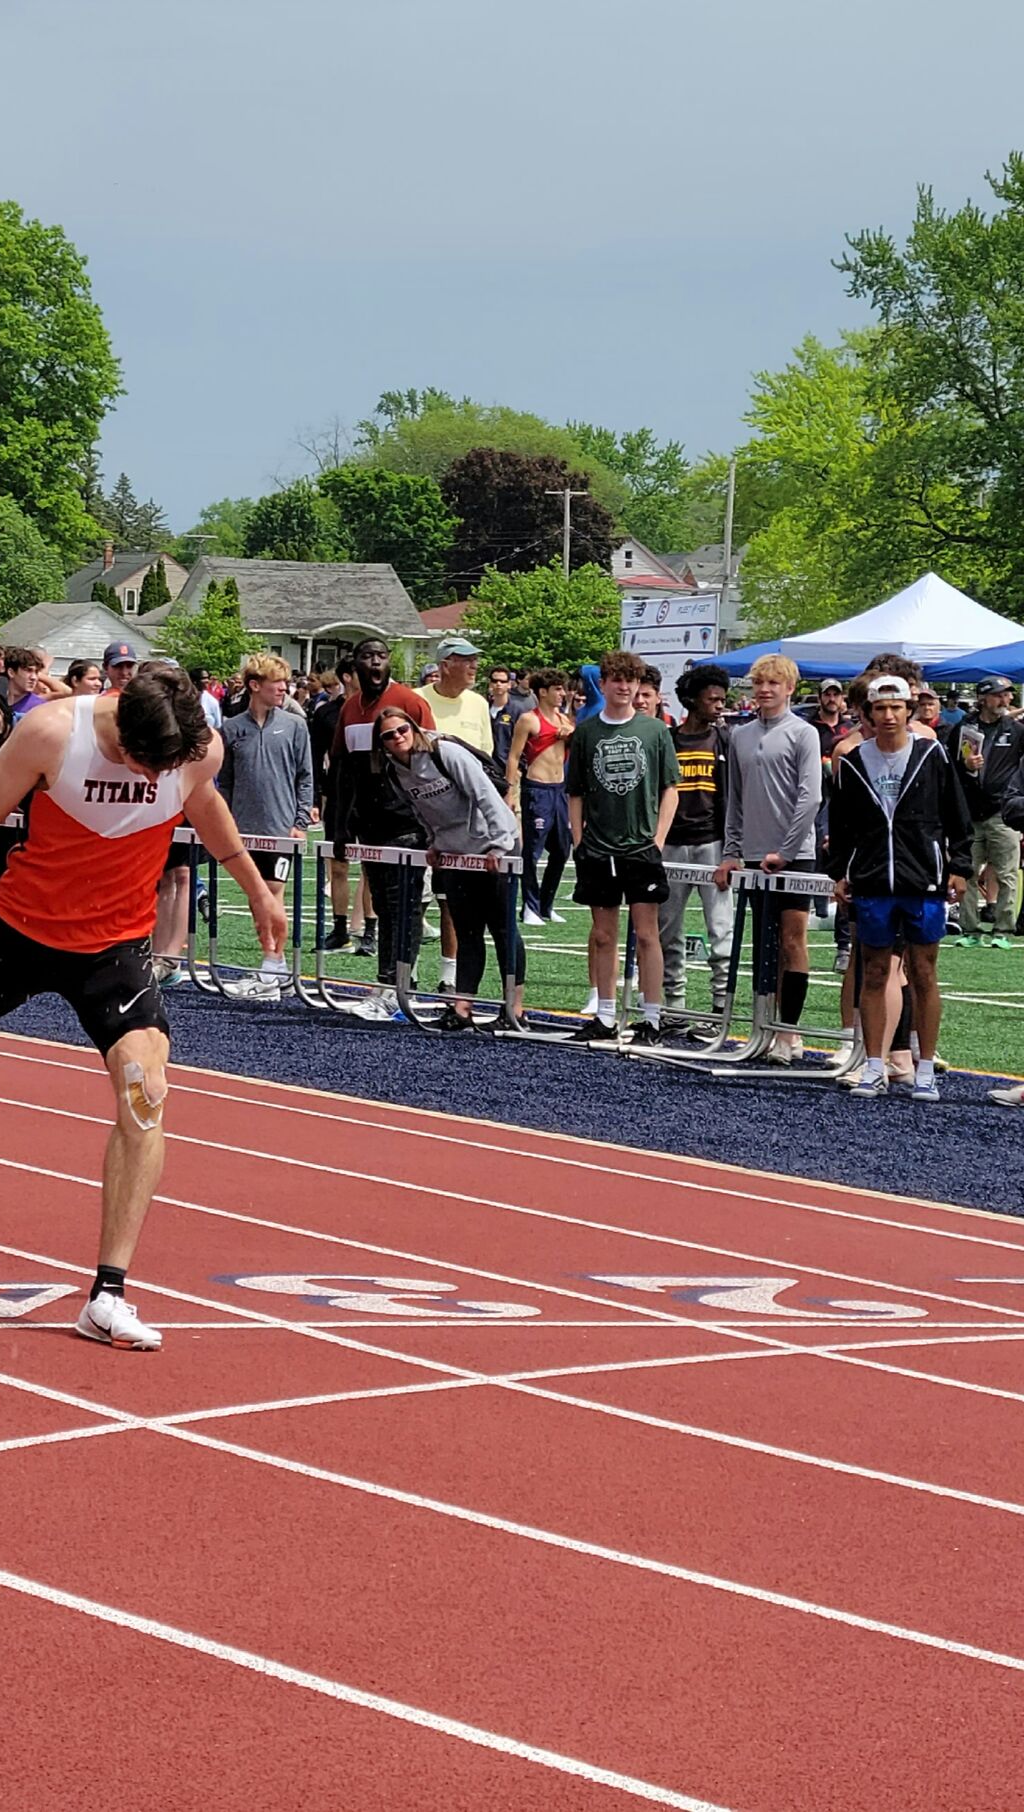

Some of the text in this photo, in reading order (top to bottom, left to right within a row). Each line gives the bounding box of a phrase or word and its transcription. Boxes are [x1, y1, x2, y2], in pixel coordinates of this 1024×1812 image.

[84, 779, 158, 804] TITANS
[344, 846, 382, 859] DDY MEET
[440, 854, 488, 869] DDY MEET
[690, 870, 715, 882] PLAC
[790, 879, 807, 891] FIRST
[226, 1274, 542, 1318] 3
[584, 1275, 929, 1319] 2
